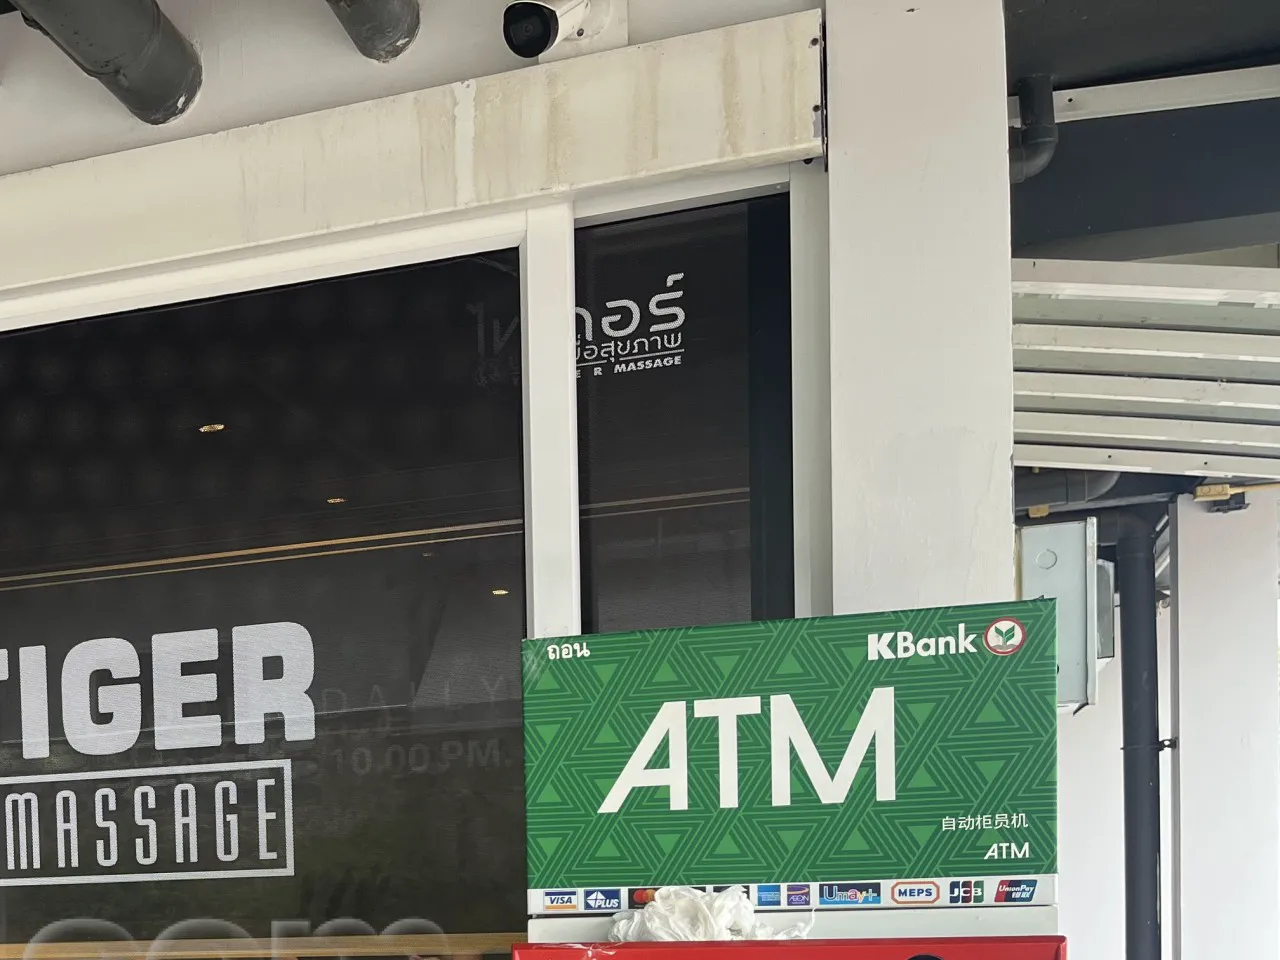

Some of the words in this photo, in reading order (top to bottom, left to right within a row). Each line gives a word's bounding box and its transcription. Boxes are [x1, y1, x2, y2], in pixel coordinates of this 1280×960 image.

[614, 355, 683, 374] MASSAGE
[546, 641, 591, 661] ถอน
[867, 623, 978, 661] KBank
[596, 687, 897, 814] ATM
[5, 778, 278, 870] MASSAGE
[941, 813, 1029, 832] 自动柜员机
[983, 842, 1030, 860] ATM
[898, 887, 933, 897] MEPS
[950, 887, 983, 897] JCB
[998, 884, 1035, 894] UnionPay
[550, 896, 573, 904] VISA
[595, 899, 620, 908] PLUS
